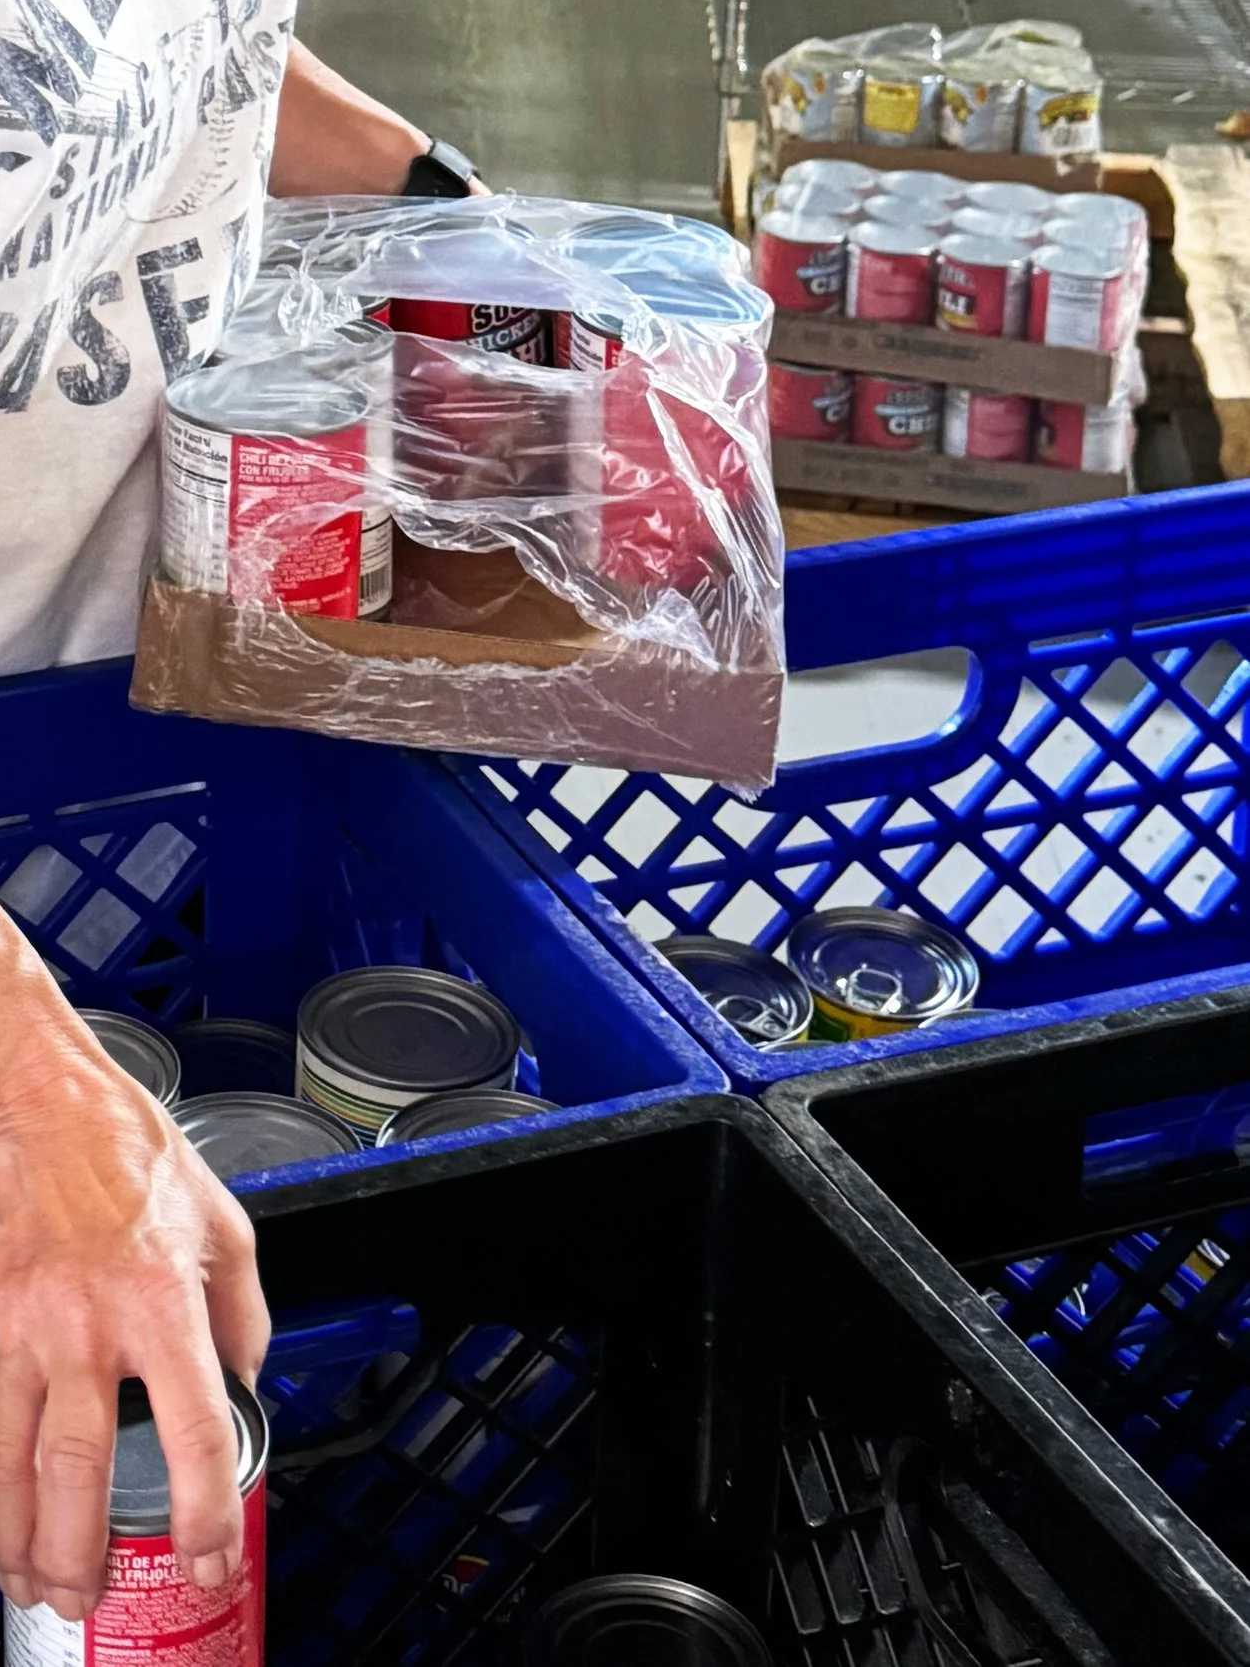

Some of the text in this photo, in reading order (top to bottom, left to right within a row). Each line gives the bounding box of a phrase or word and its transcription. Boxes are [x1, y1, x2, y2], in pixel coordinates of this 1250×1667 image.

[132, 1556, 151, 1569] DE
[153, 1552, 178, 1567] POL
[124, 1565, 183, 1582] FRIJOLE
